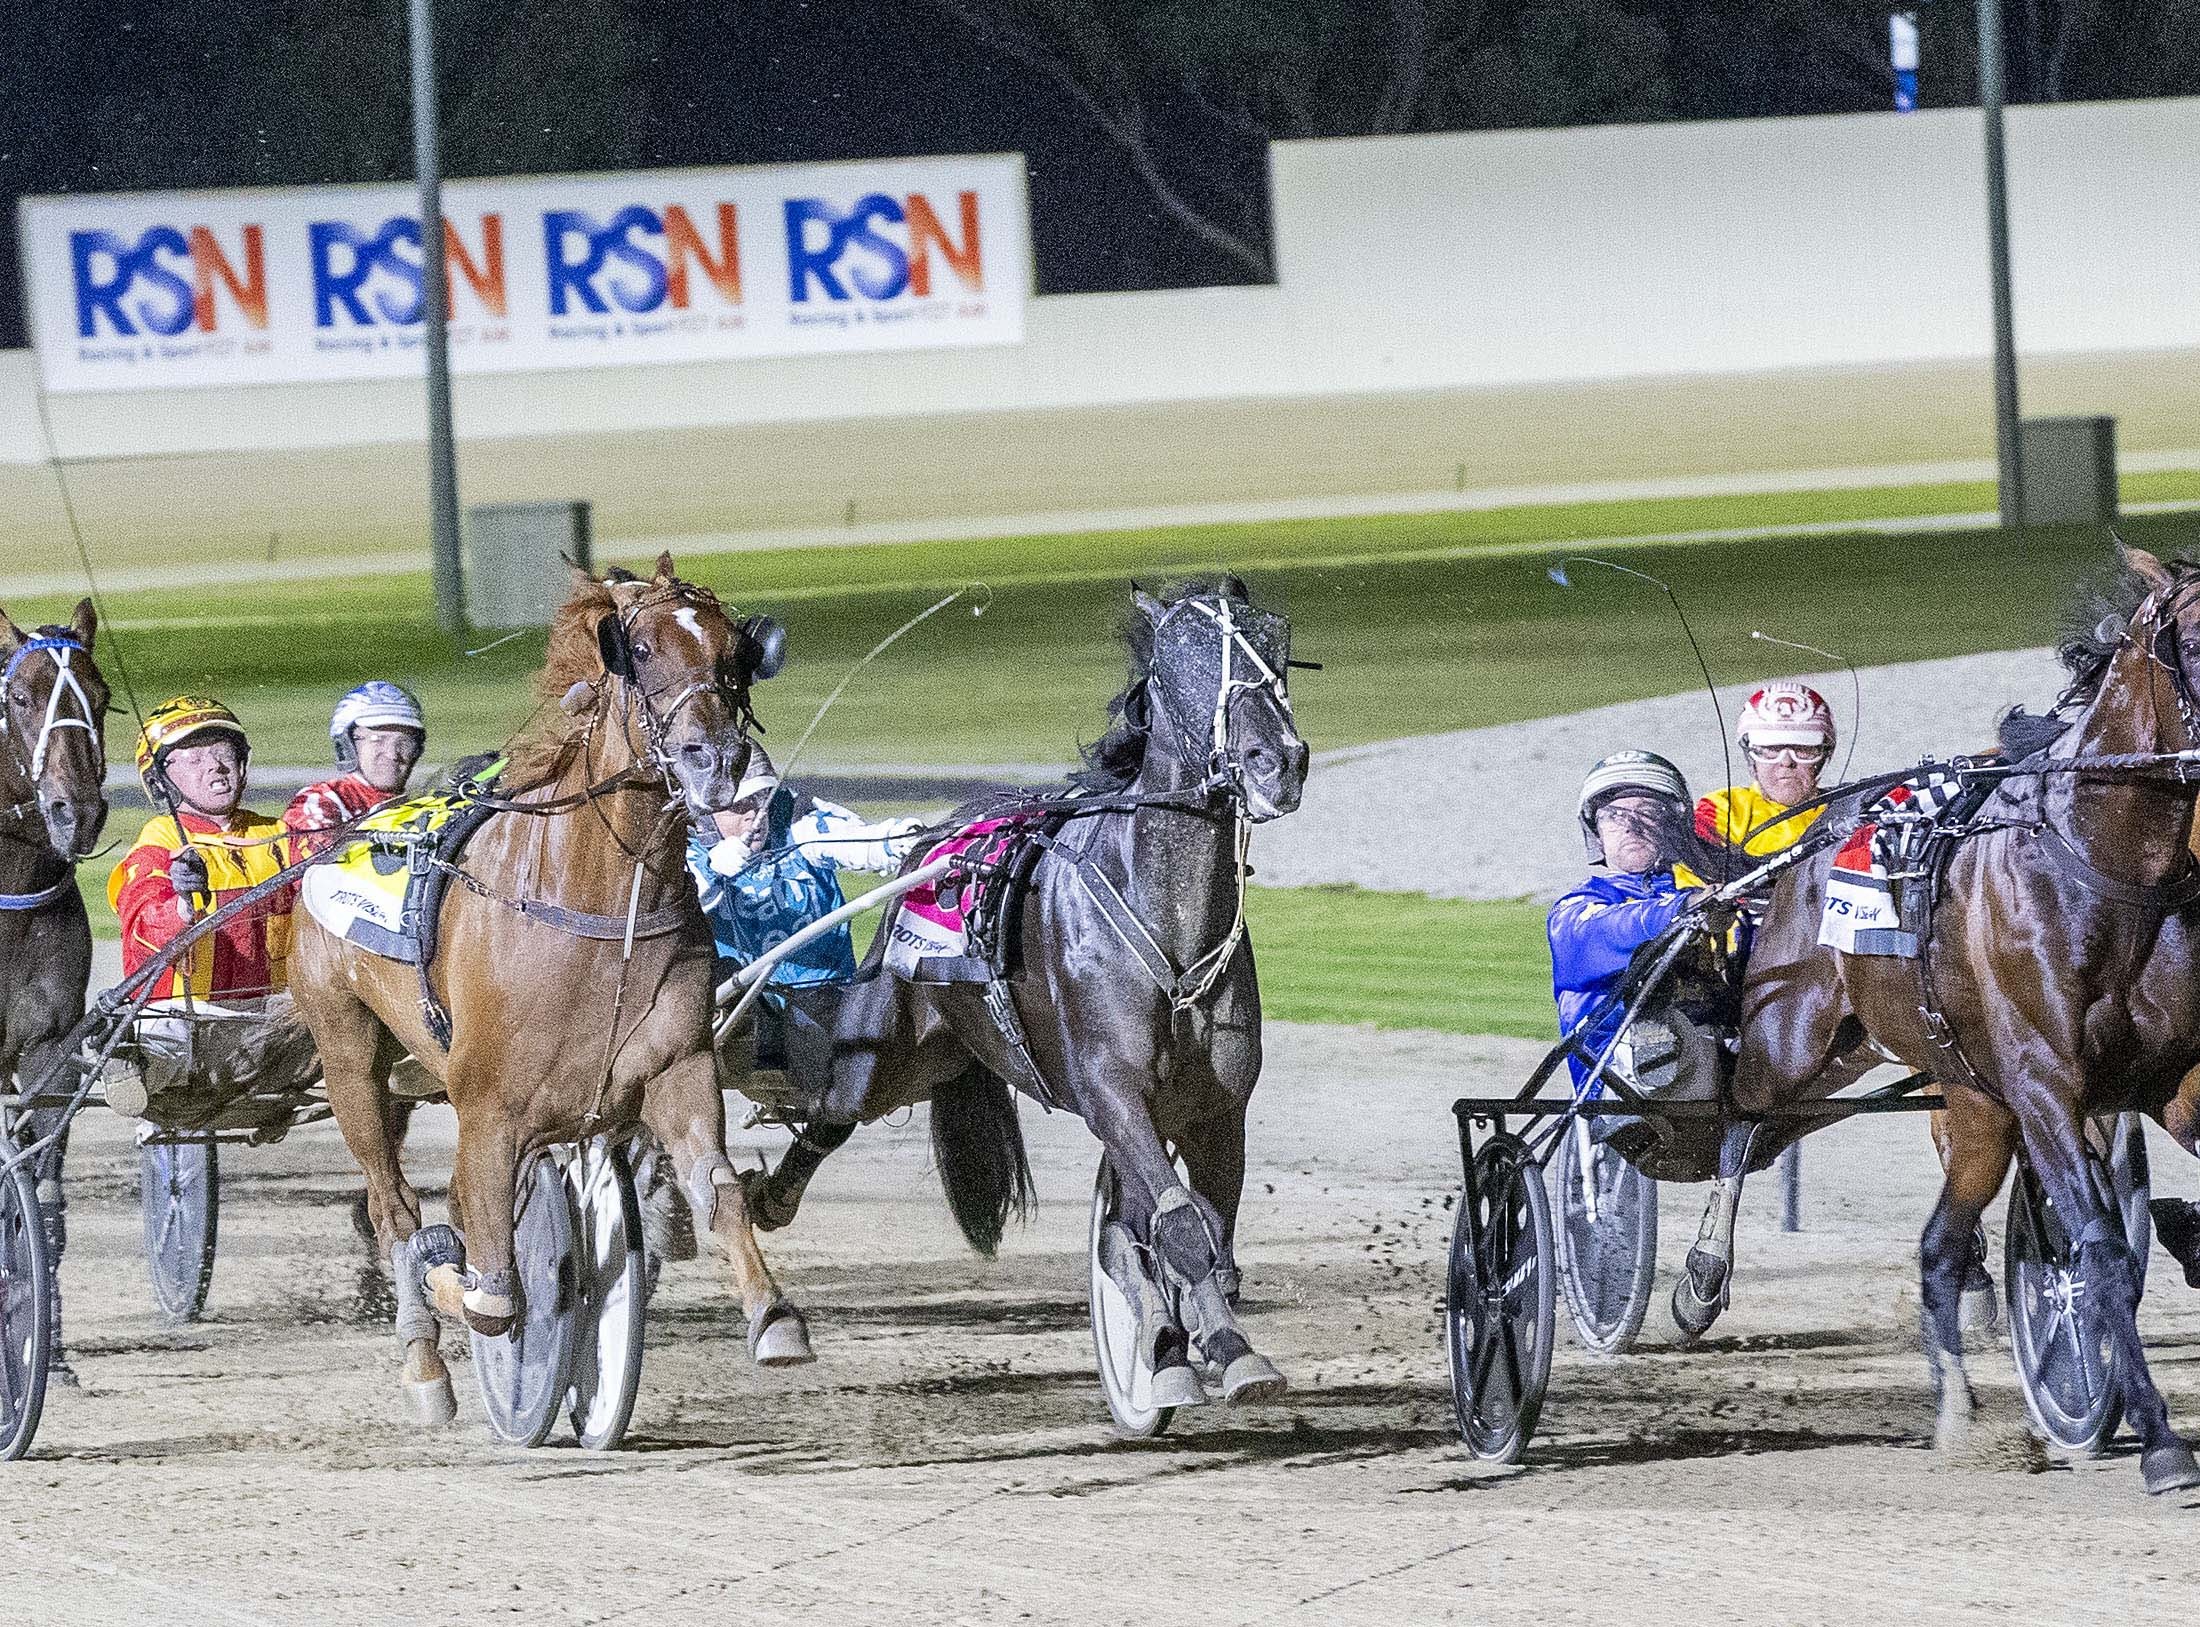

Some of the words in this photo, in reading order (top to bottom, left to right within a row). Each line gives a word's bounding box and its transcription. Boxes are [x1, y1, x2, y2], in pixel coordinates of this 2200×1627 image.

[69, 224, 269, 337] RSN
[307, 213, 508, 327] RSN
[541, 202, 742, 315] RSN
[784, 190, 984, 302] RSN
